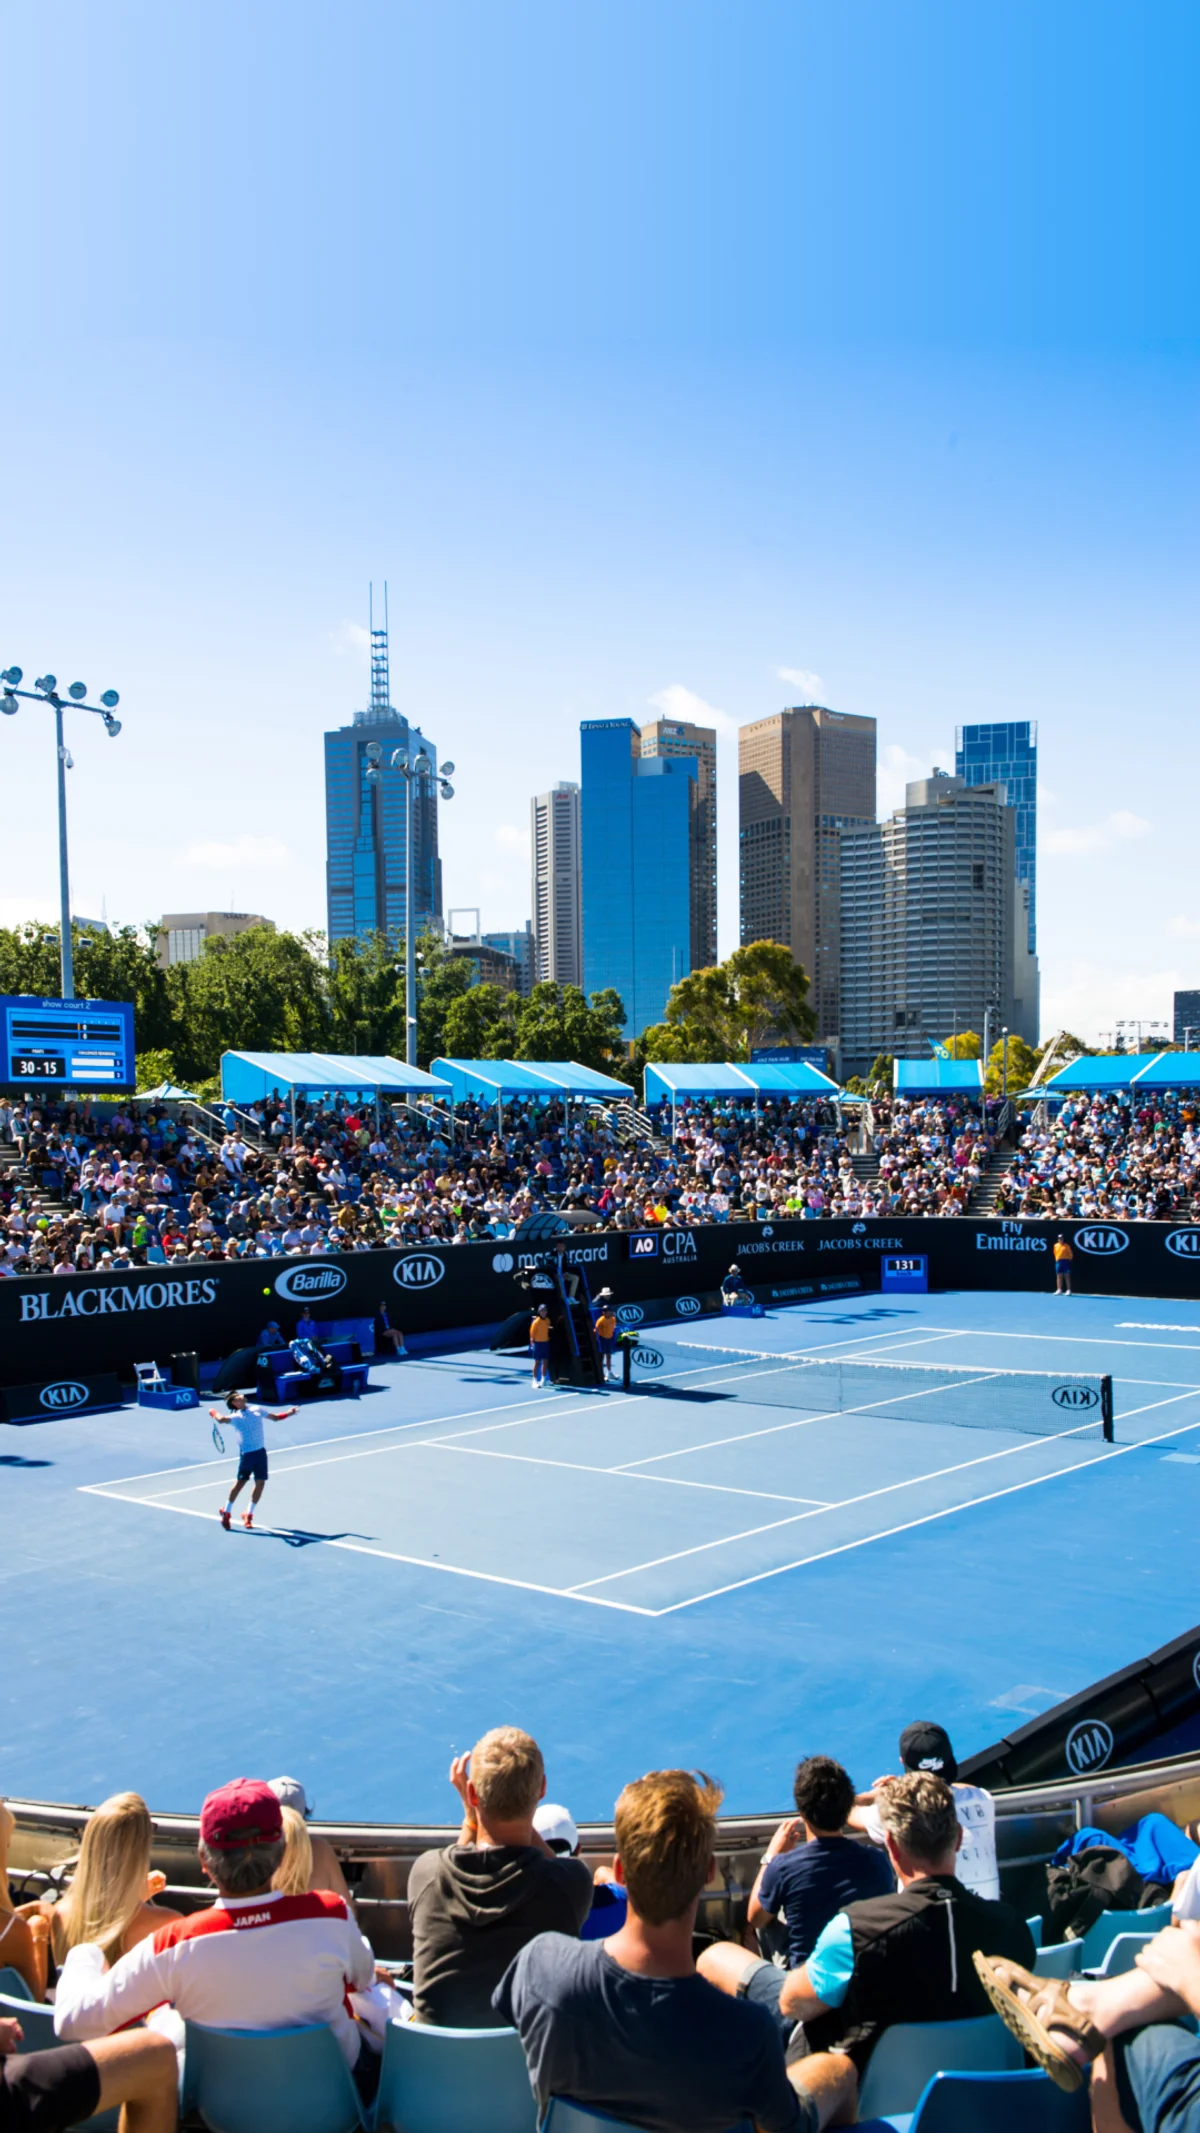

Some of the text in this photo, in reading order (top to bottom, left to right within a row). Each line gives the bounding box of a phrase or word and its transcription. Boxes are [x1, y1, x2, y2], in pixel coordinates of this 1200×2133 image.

[42, 1000, 61, 1009] show
[64, 1002, 84, 1010] court
[20, 1061, 35, 1075] 30
[43, 1061, 57, 1075] 15
[1002, 1220, 1023, 1236] Fly
[635, 1237, 654, 1253] AO
[662, 1230, 697, 1256] CPA
[771, 1240, 805, 1253] CREEK
[864, 1237, 903, 1250] CREEK
[976, 1232, 1048, 1251] Emirates
[1083, 1231, 1120, 1248] KIA
[1175, 1234, 1200, 1252] KI
[662, 1254, 698, 1265] AUSTRALIA
[895, 1259, 914, 1270] 131
[402, 1261, 437, 1283] KIA
[292, 1271, 341, 1291] Barilla
[19, 1278, 217, 1322] BLACKMORES
[47, 1386, 82, 1405] KIA
[1071, 1728, 1108, 1769] KIA
[233, 1910, 271, 1927] JAPAN
